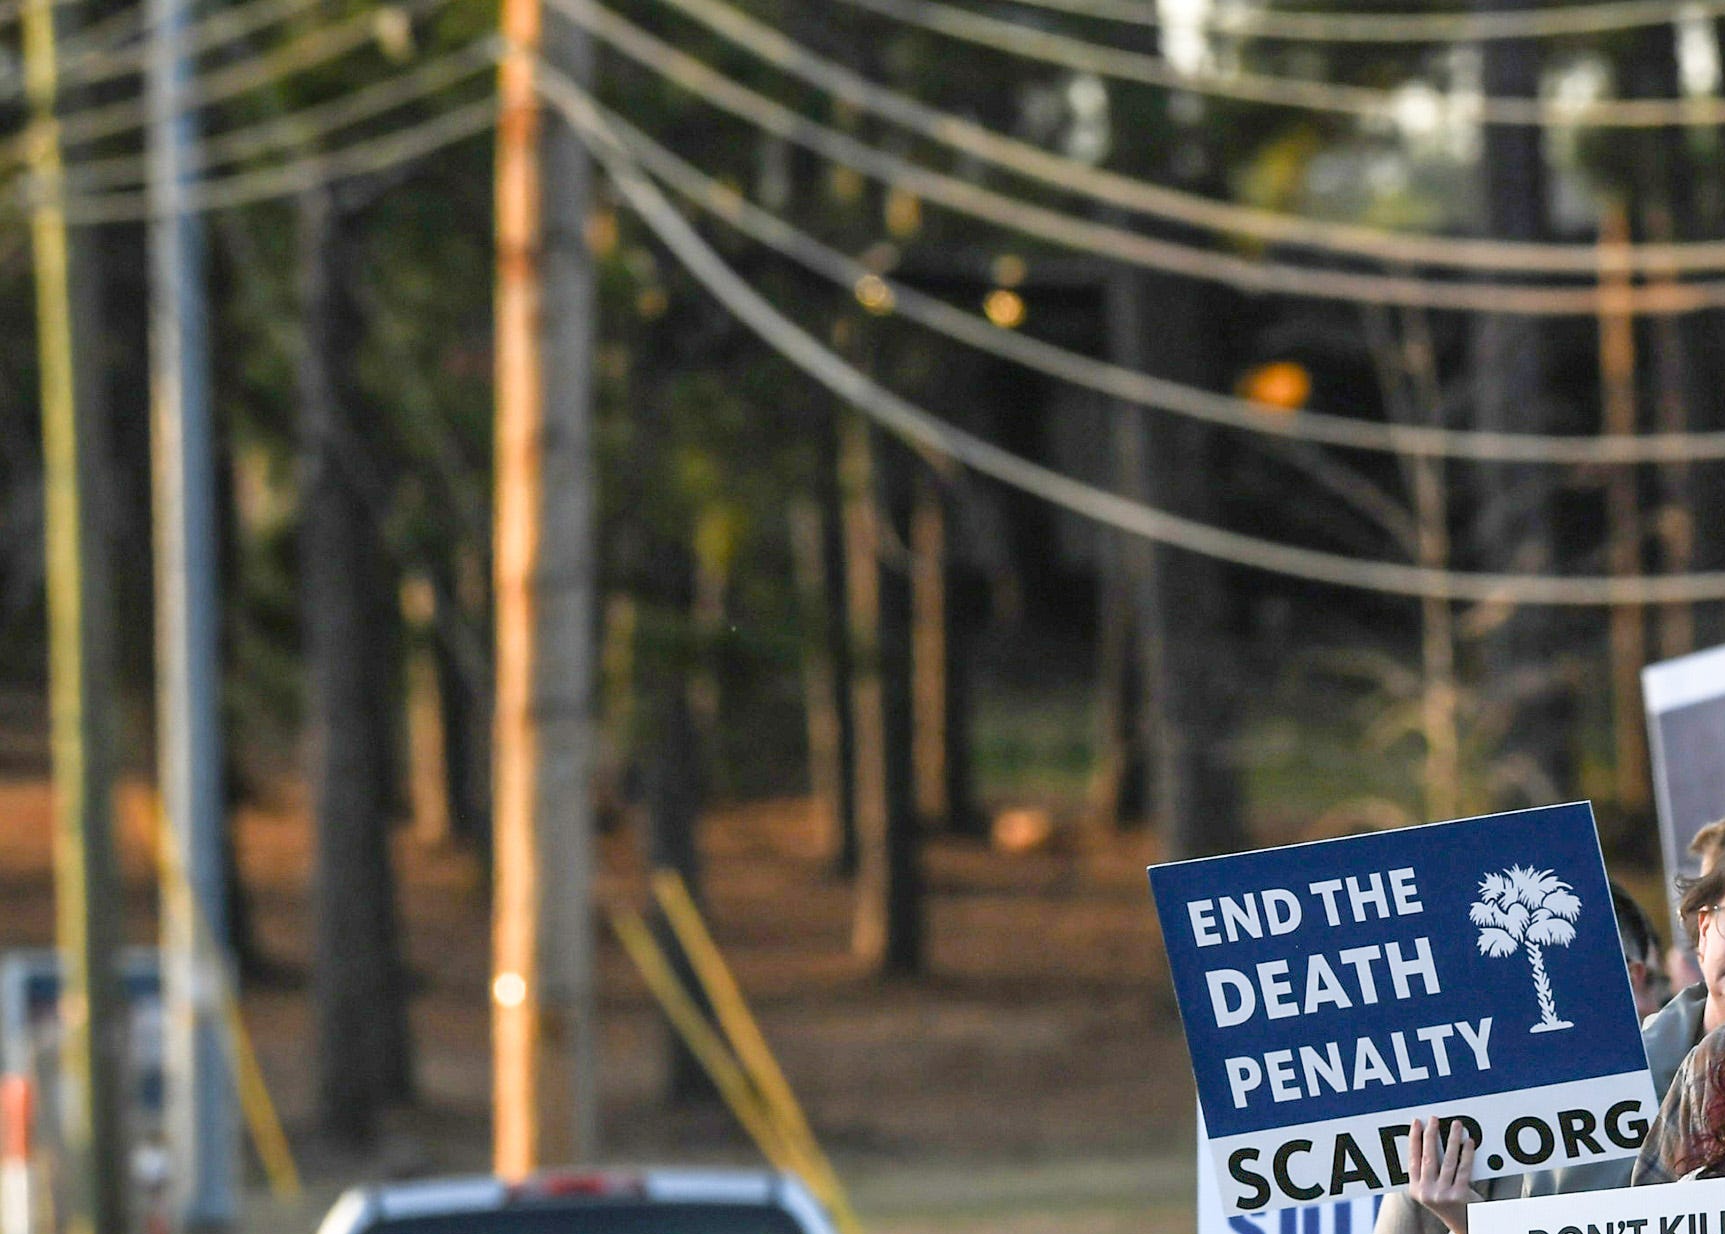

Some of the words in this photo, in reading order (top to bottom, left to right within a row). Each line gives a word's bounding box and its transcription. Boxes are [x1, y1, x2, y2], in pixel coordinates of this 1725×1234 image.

[1187, 888, 1302, 948] END
[1310, 867, 1424, 926] THE
[1206, 937, 1441, 1028] DEATH
[1224, 1017, 1493, 1109] PENALTY
